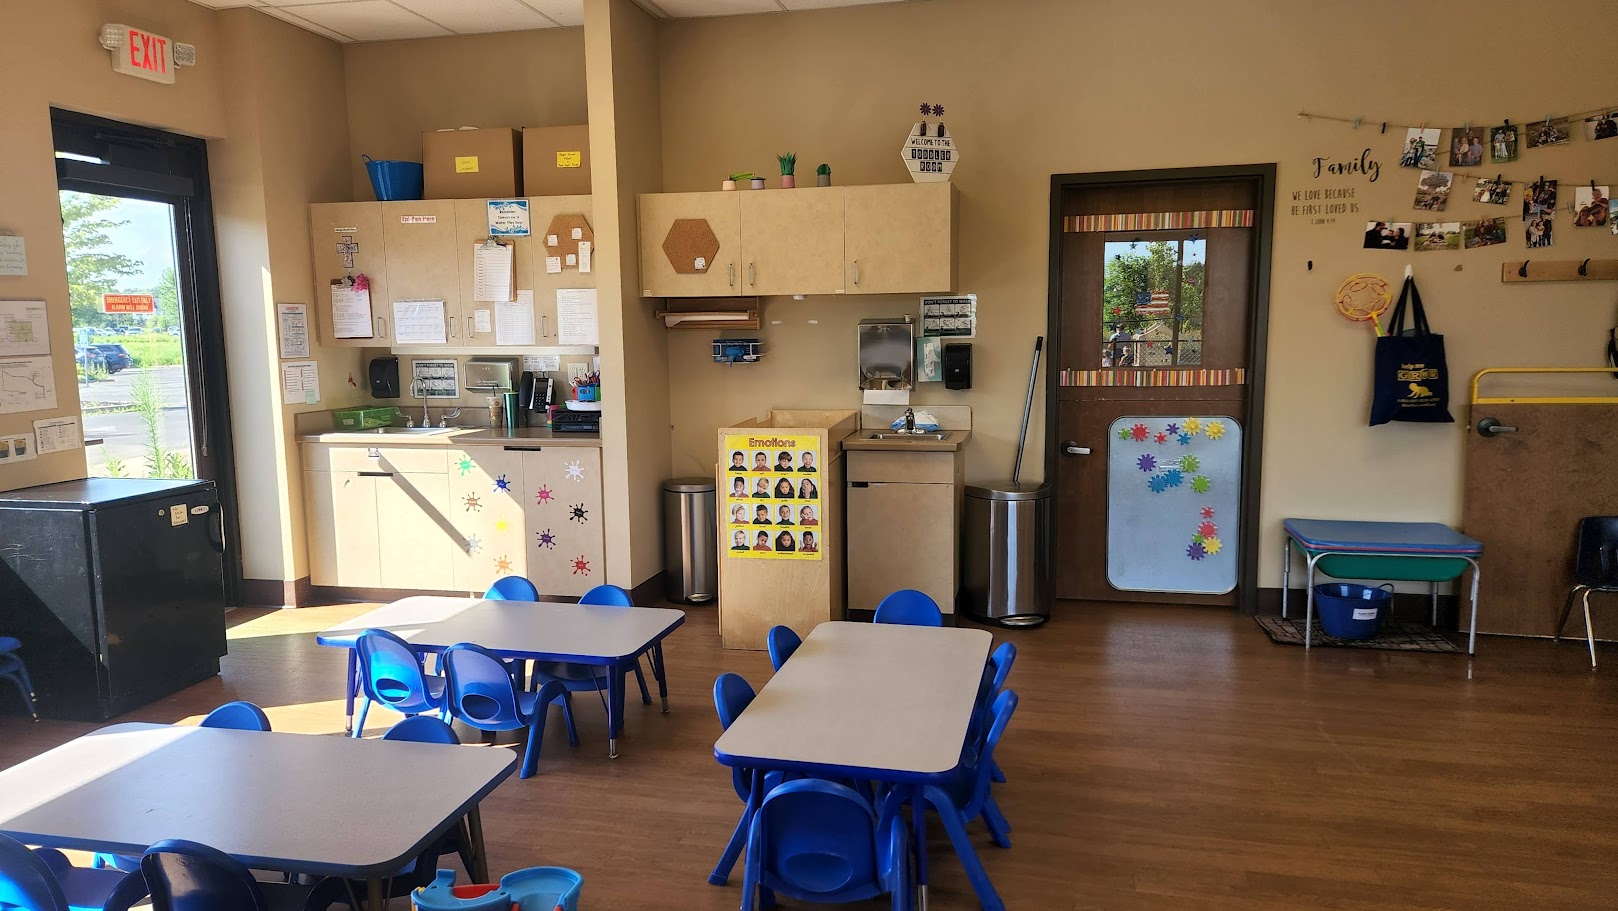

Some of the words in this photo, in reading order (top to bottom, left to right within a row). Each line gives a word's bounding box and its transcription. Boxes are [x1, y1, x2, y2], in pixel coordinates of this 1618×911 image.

[129, 30, 166, 74] EXIT
[911, 138, 933, 146] WELCOME
[912, 148, 950, 160] TODDLER
[920, 162, 942, 172] ROOM
[1312, 148, 1382, 182] Family
[1292, 190, 1301, 200] WE
[1304, 190, 1320, 200] LOVE
[1324, 188, 1356, 200] BECAUSE
[1291, 205, 1298, 216] HE
[1302, 204, 1322, 215] FIRST
[1326, 203, 1346, 214] LOVED
[1350, 202, 1359, 214] US
[1398, 369, 1438, 381] GR
[748, 438, 796, 448] Emotions
